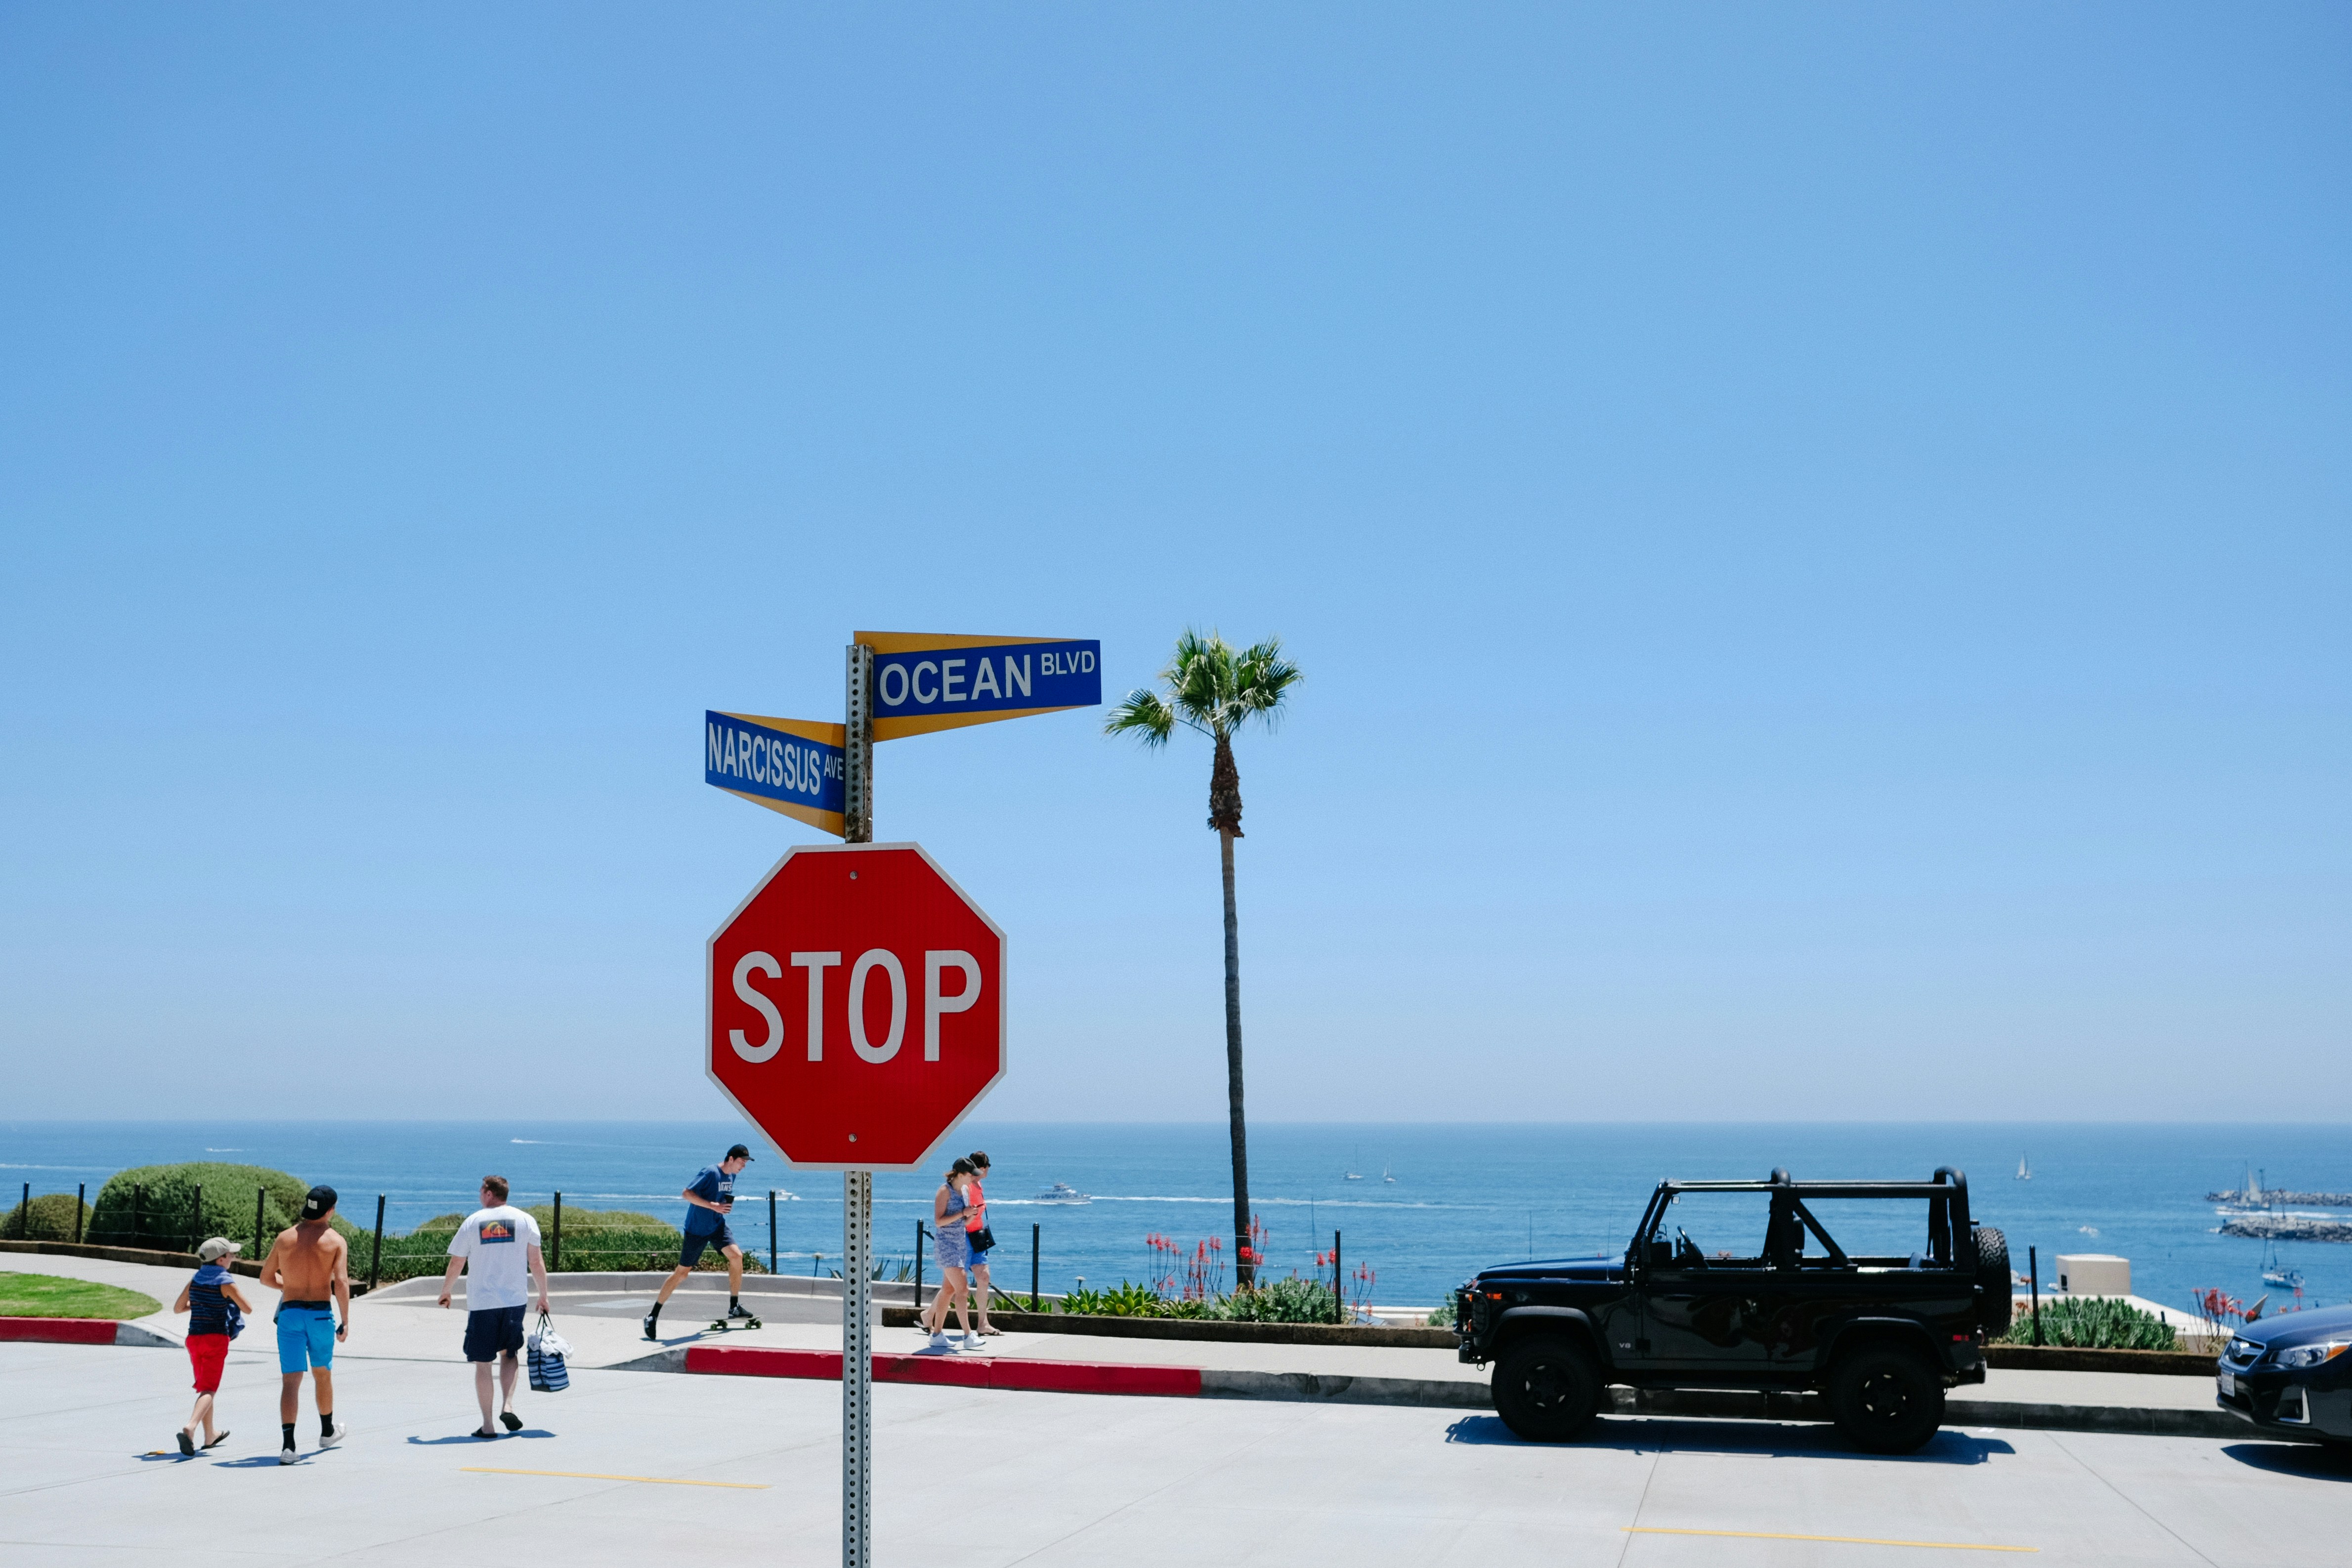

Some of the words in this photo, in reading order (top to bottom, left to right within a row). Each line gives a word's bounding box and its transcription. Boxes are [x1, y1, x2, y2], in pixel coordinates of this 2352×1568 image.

[880, 654, 1031, 706] OCEAN
[1041, 650, 1095, 676] BLVD
[708, 722, 820, 795] NARCISSUS
[823, 754, 844, 781] AVE
[729, 948, 982, 1063] STOP
[718, 1182, 732, 1192] VANS
